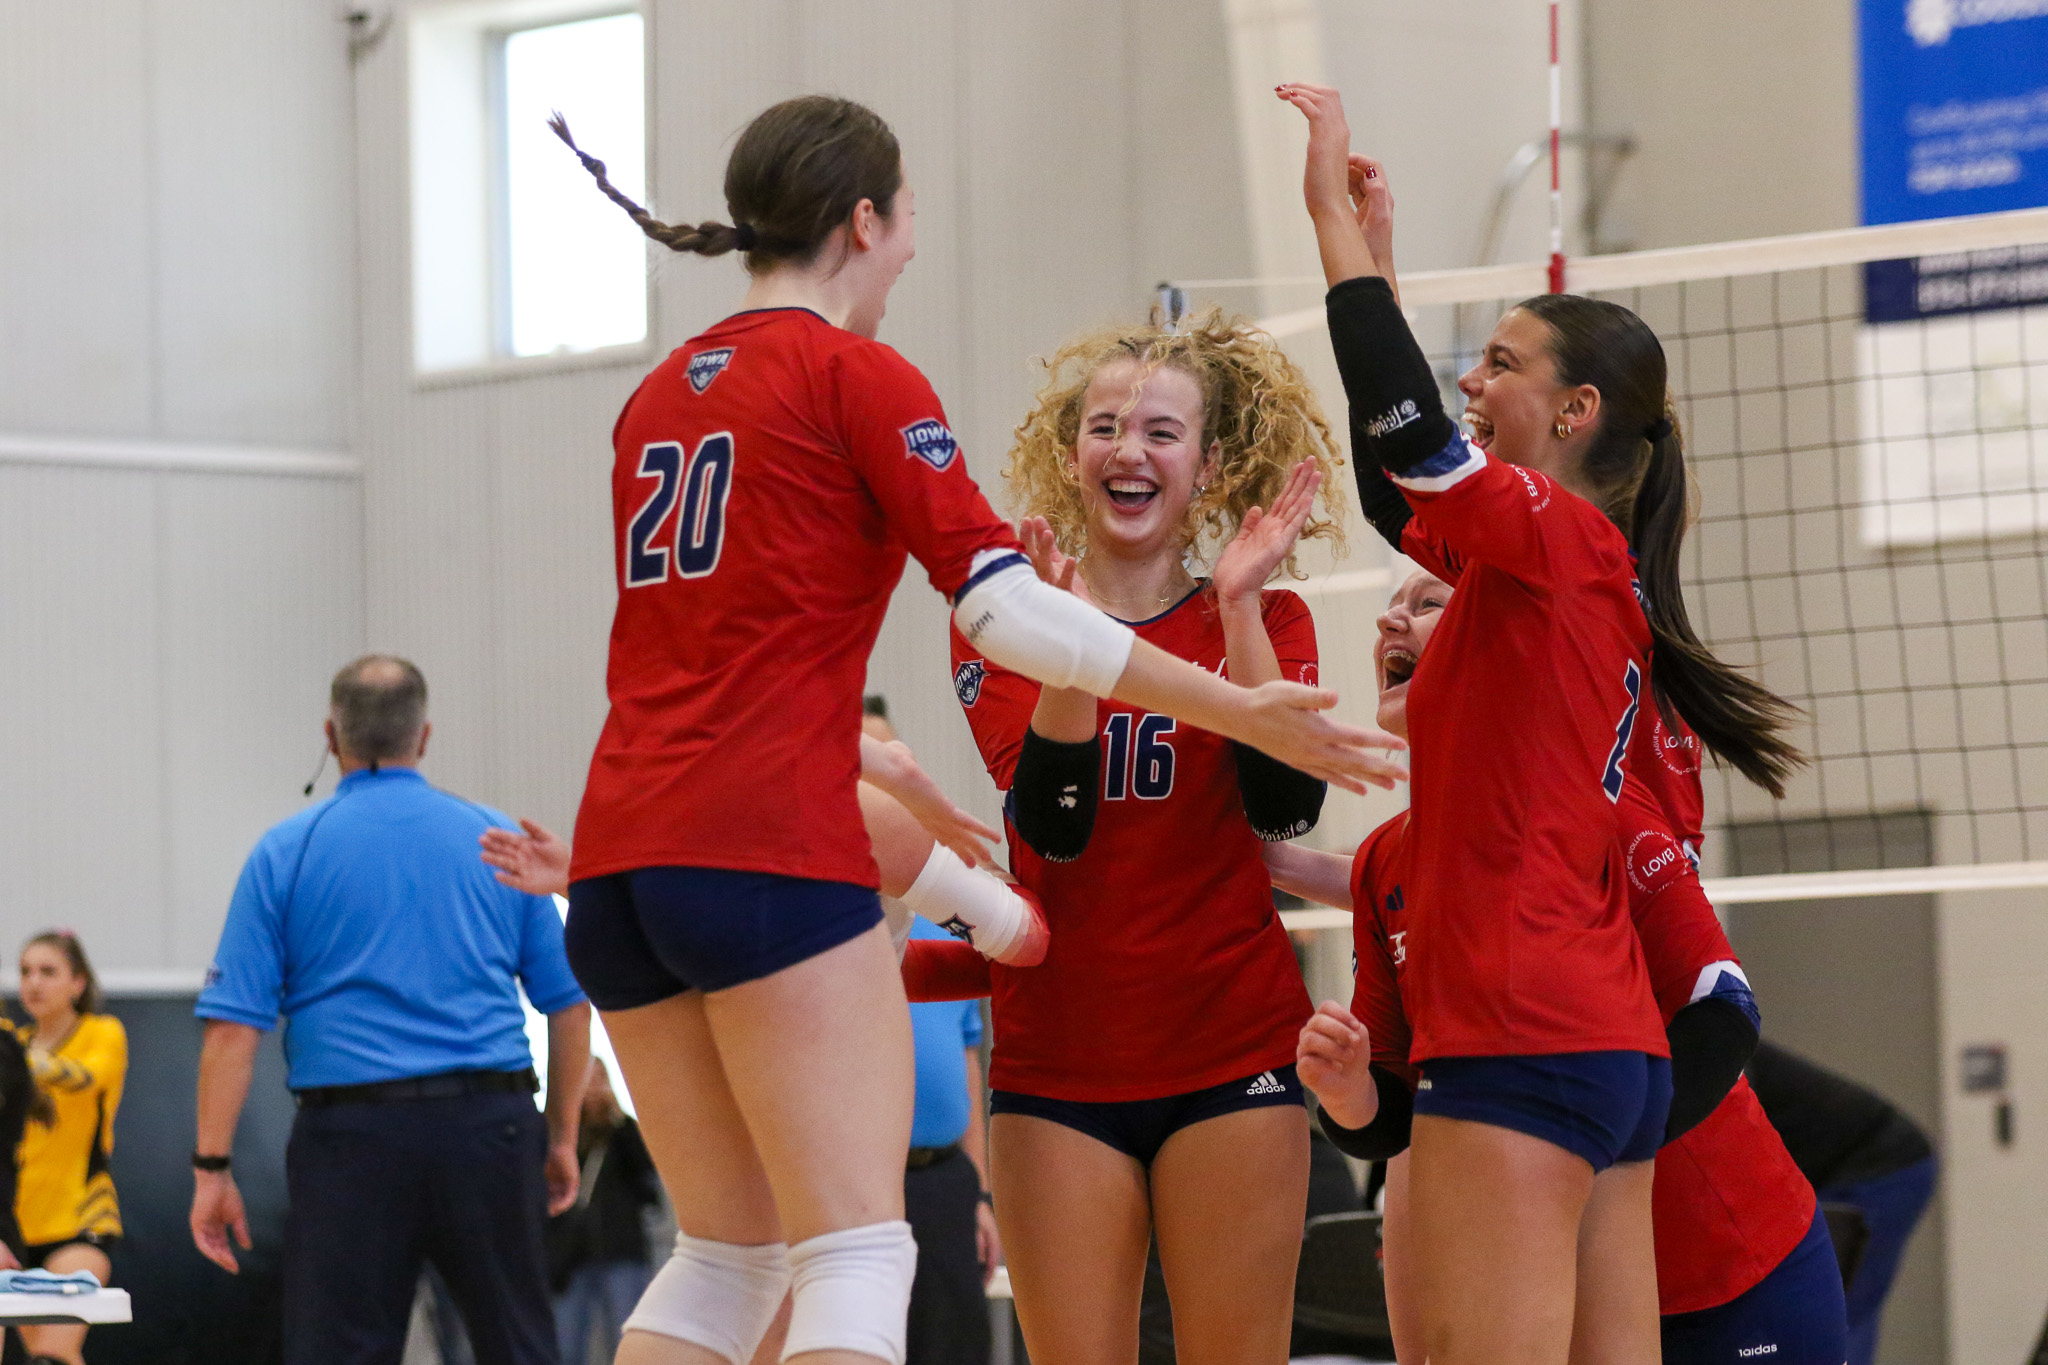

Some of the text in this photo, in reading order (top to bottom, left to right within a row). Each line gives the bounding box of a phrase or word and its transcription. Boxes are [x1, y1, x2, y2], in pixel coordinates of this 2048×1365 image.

[690, 352, 731, 370] IOWA
[908, 426, 955, 448] IOWA
[626, 431, 735, 588] 20
[955, 664, 981, 694] IOWA
[1103, 713, 1177, 801] 16
[1653, 735, 1664, 759] LEAGUE
[1628, 830, 1655, 854] VOLLEYBALL
[1641, 847, 1676, 878] LOVB
[1628, 870, 1647, 892] LEAGUE
[1246, 1084, 1287, 1095] adidas
